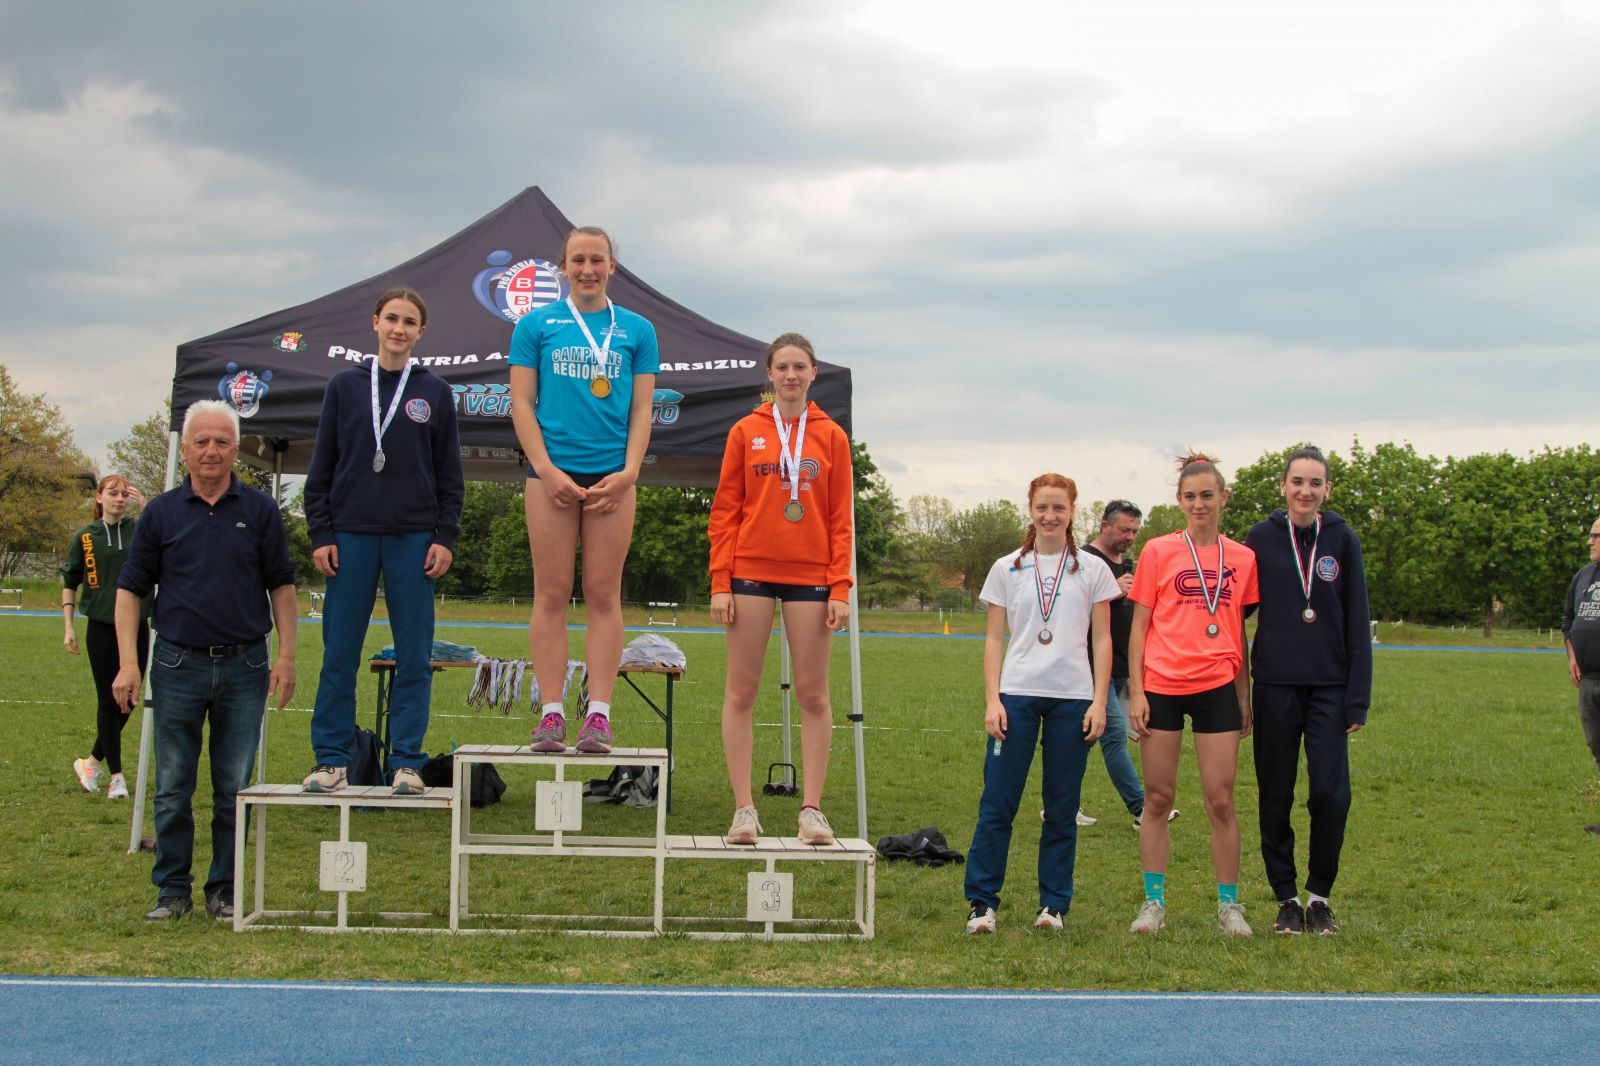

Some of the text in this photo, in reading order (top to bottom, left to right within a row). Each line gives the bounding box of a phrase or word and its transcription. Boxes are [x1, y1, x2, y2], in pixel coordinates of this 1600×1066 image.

[515, 277, 532, 289] B
[514, 295, 530, 306] B
[409, 355, 479, 366] ATRIA
[552, 346, 623, 367] CAMPINE
[553, 362, 620, 380] REGIONLE
[551, 791, 563, 823] 1
[335, 851, 355, 883] 2
[761, 880, 780, 911] 3
